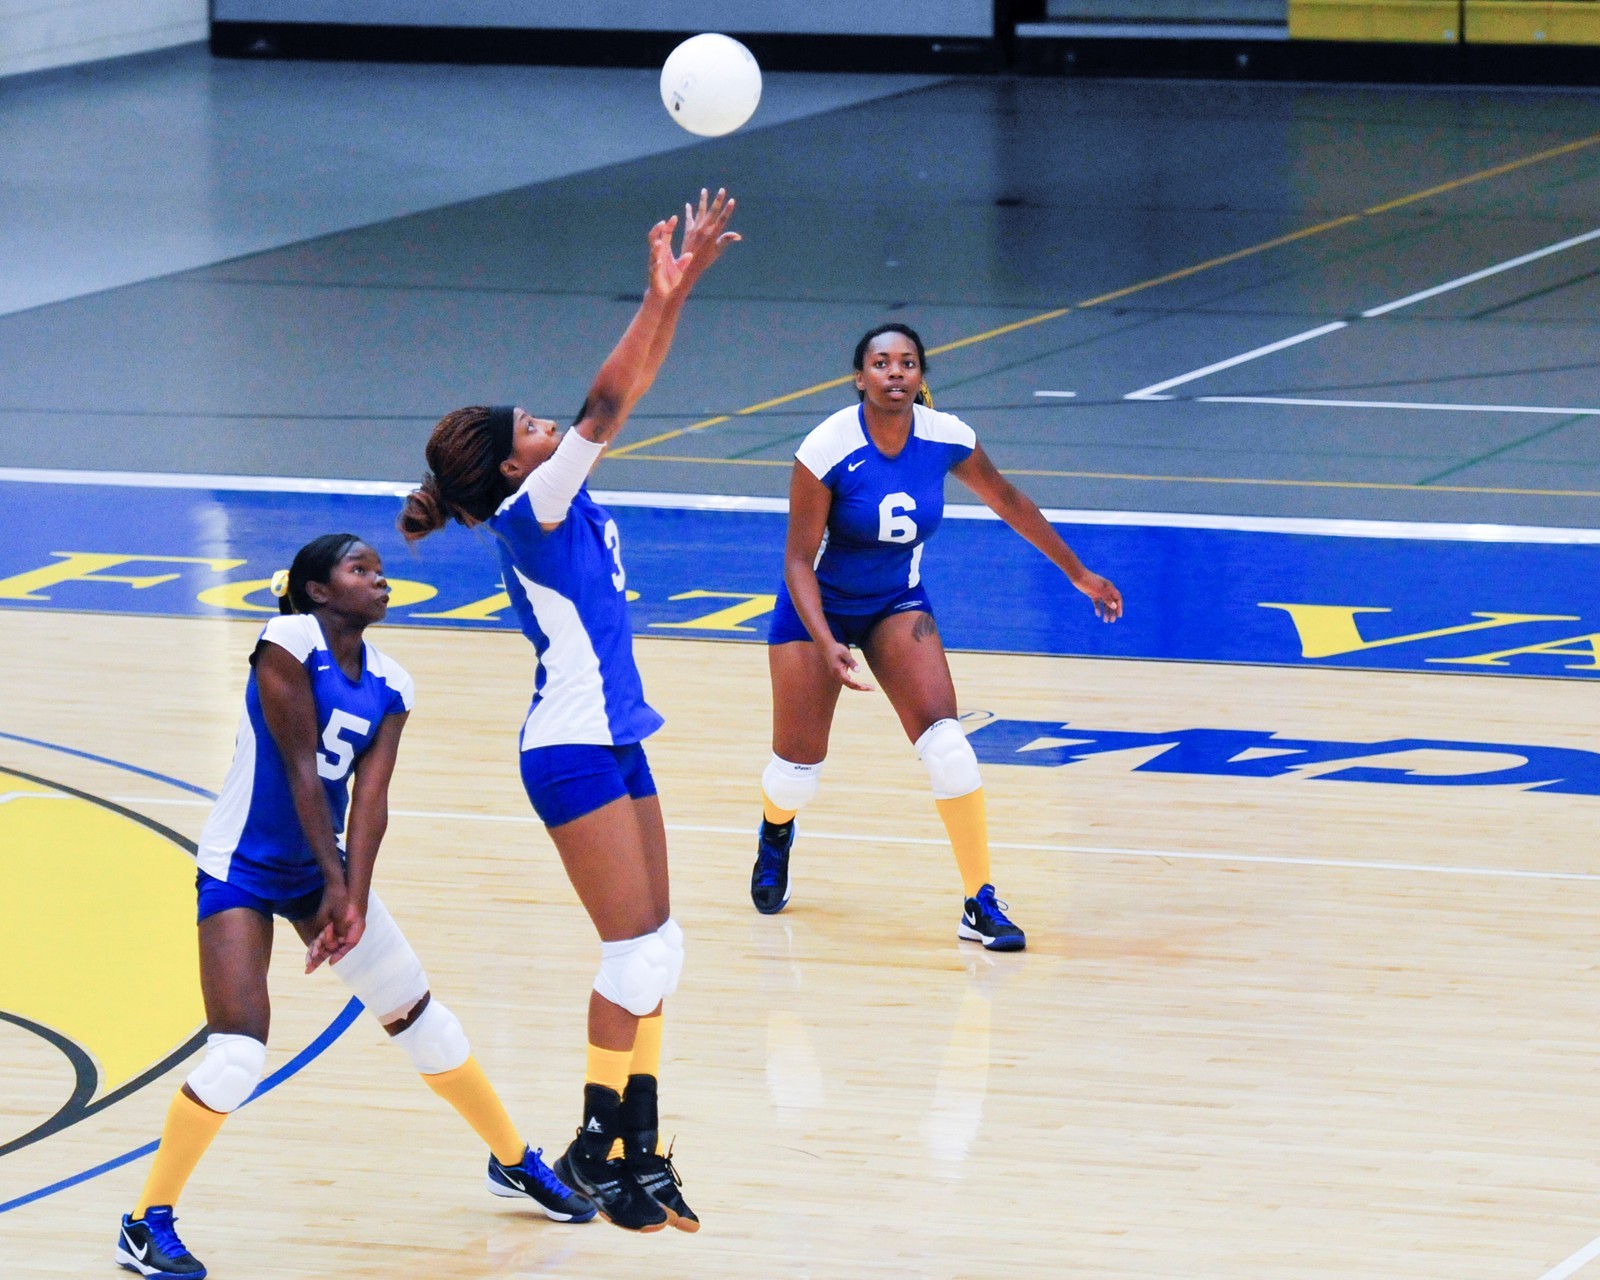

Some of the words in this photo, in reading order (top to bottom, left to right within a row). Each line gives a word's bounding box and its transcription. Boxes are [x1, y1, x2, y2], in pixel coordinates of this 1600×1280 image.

[878, 492, 917, 544] 6
[604, 518, 626, 592] 3
[316, 708, 371, 781] 5
[918, 719, 1600, 796] CAA
